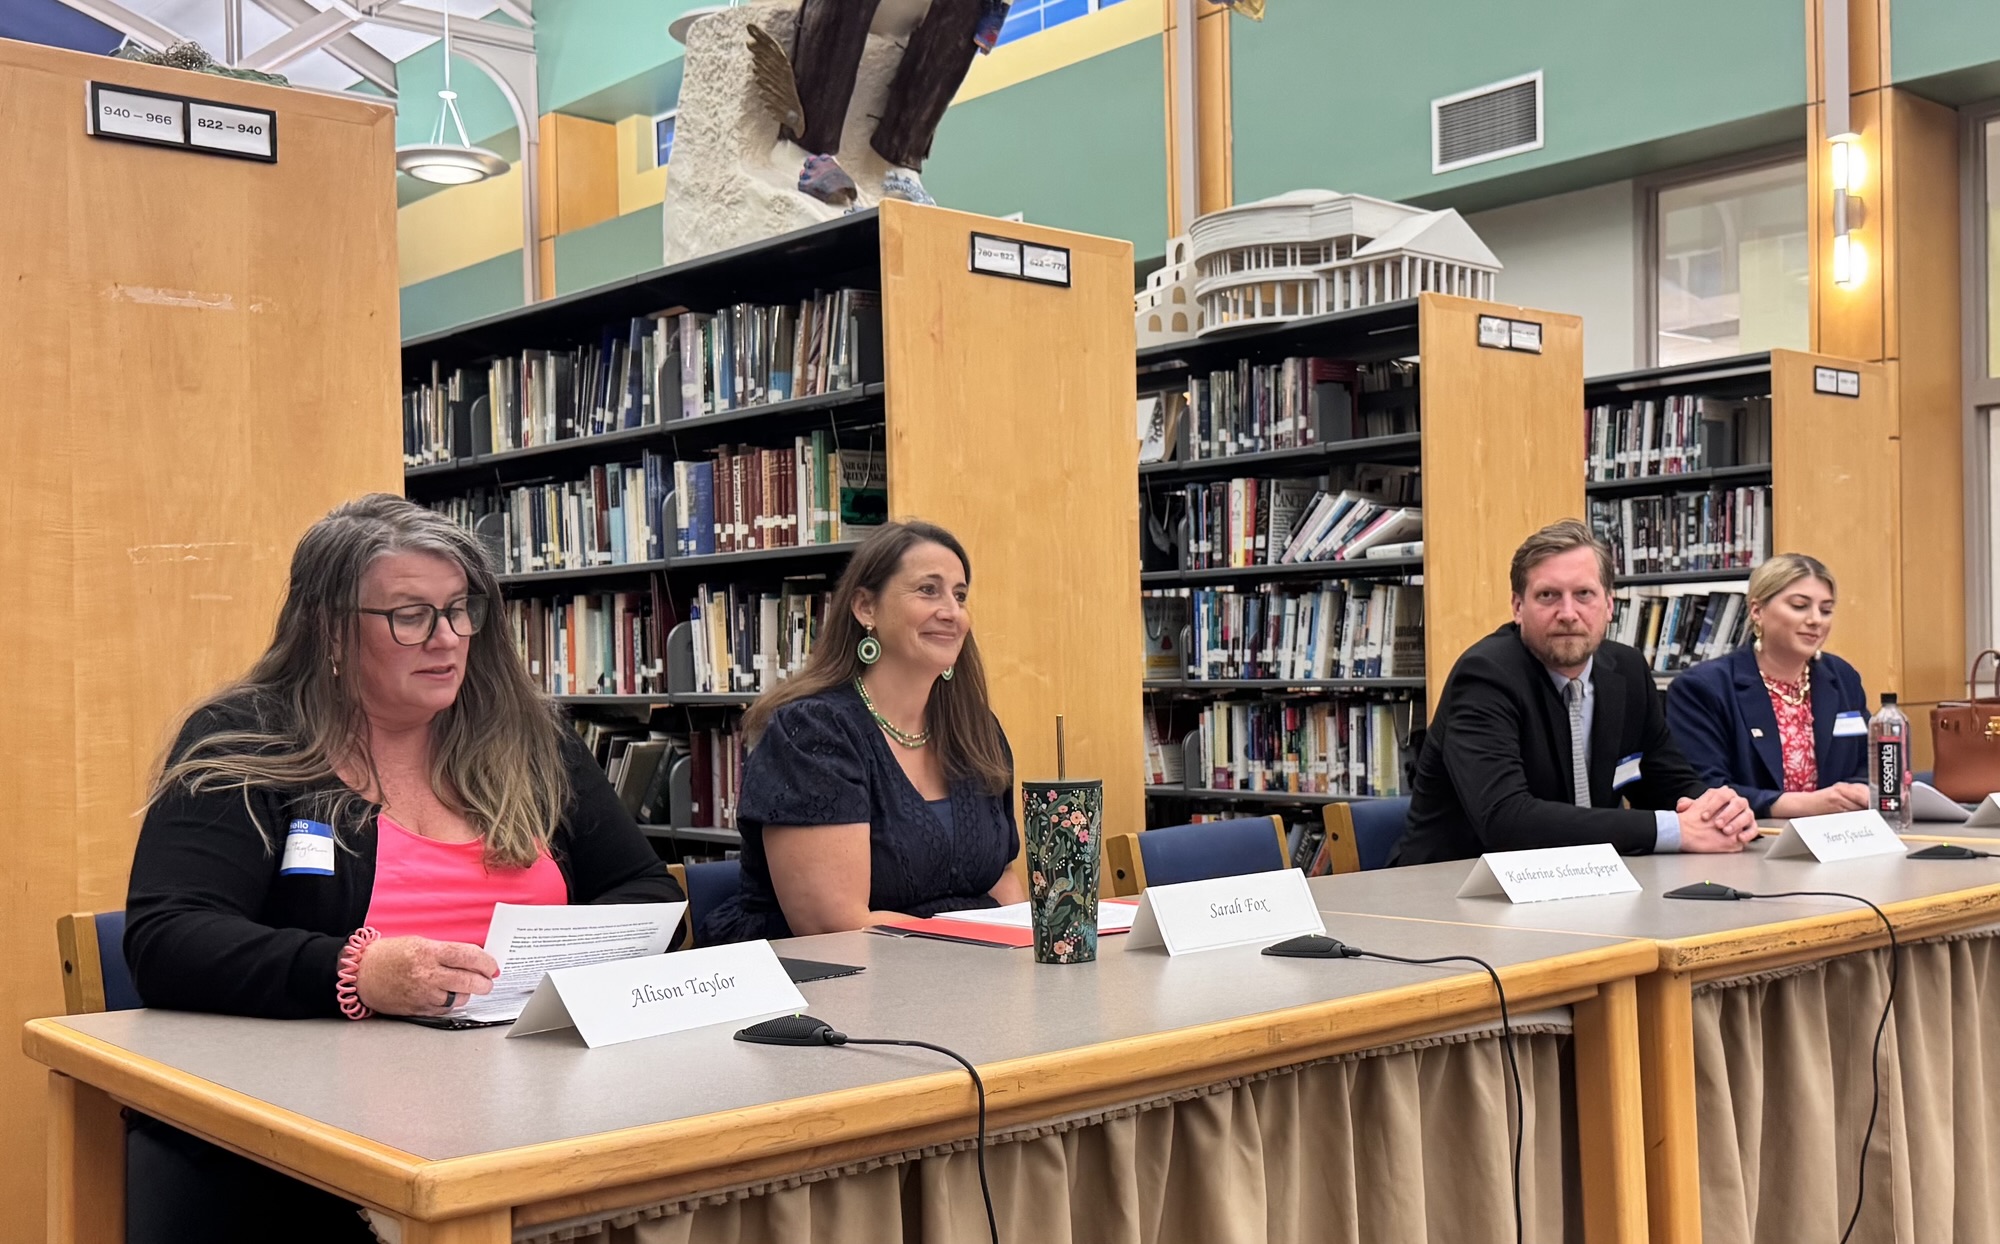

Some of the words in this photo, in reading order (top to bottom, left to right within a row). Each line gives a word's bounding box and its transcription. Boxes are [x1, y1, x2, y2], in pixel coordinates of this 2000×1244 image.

[103, 106, 130, 118] 940
[146, 113, 172, 125] 966
[197, 118, 223, 130] 822
[237, 123, 262, 135] 940
[1881, 744, 1893, 794] essentia
[1505, 868, 1555, 883] Katherine
[1555, 862, 1619, 878] Schmeckpeper
[1210, 897, 1243, 919] Sarah
[1244, 897, 1271, 912] Fox
[631, 984, 684, 1008] Alison
[685, 972, 735, 997] Taylor
